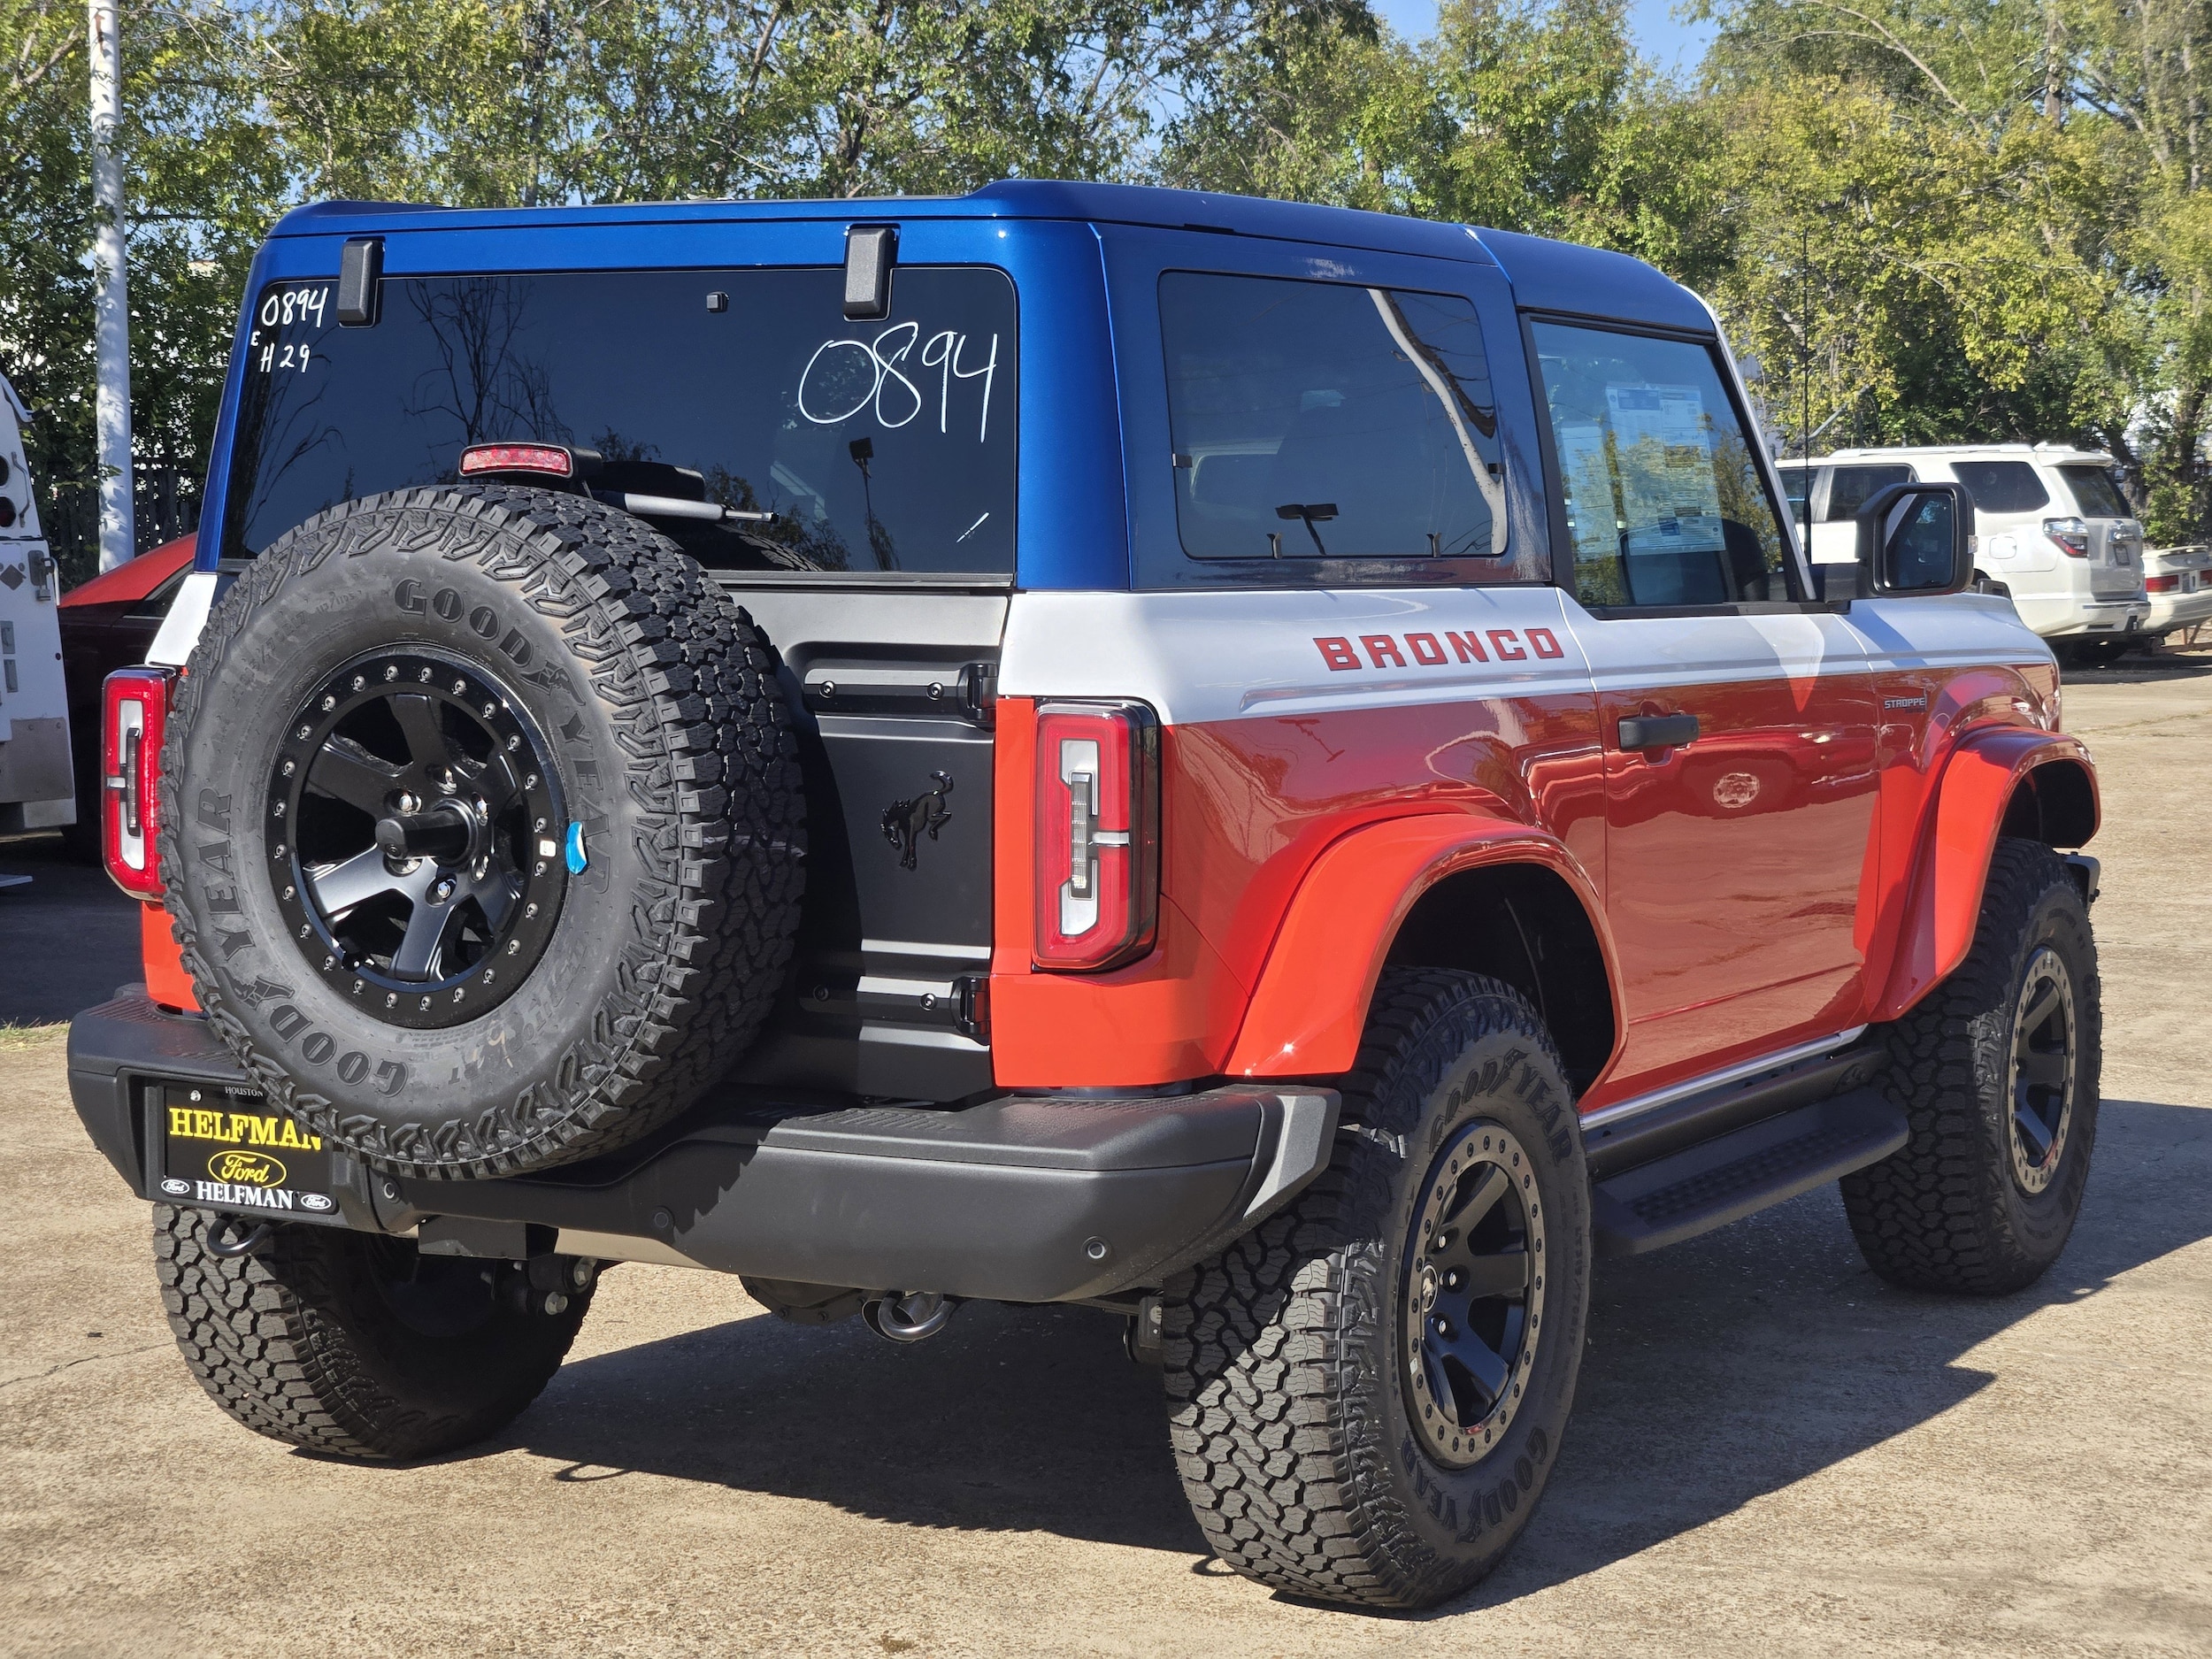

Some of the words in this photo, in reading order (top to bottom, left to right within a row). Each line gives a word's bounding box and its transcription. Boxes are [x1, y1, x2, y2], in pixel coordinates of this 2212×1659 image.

[262, 287, 328, 327] 0894
[798, 321, 999, 443] 0894
[1312, 627, 1564, 671] BRONCO
[1884, 697, 1925, 710] STROPPE
[196, 787, 408, 1097] GOODYEAR
[225, 1086, 264, 1097] HOUSTON
[221, 1154, 271, 1184] Ford
[165, 1180, 188, 1193] Ford
[196, 1180, 294, 1210] HELFMAN
[303, 1195, 328, 1208] Ford
